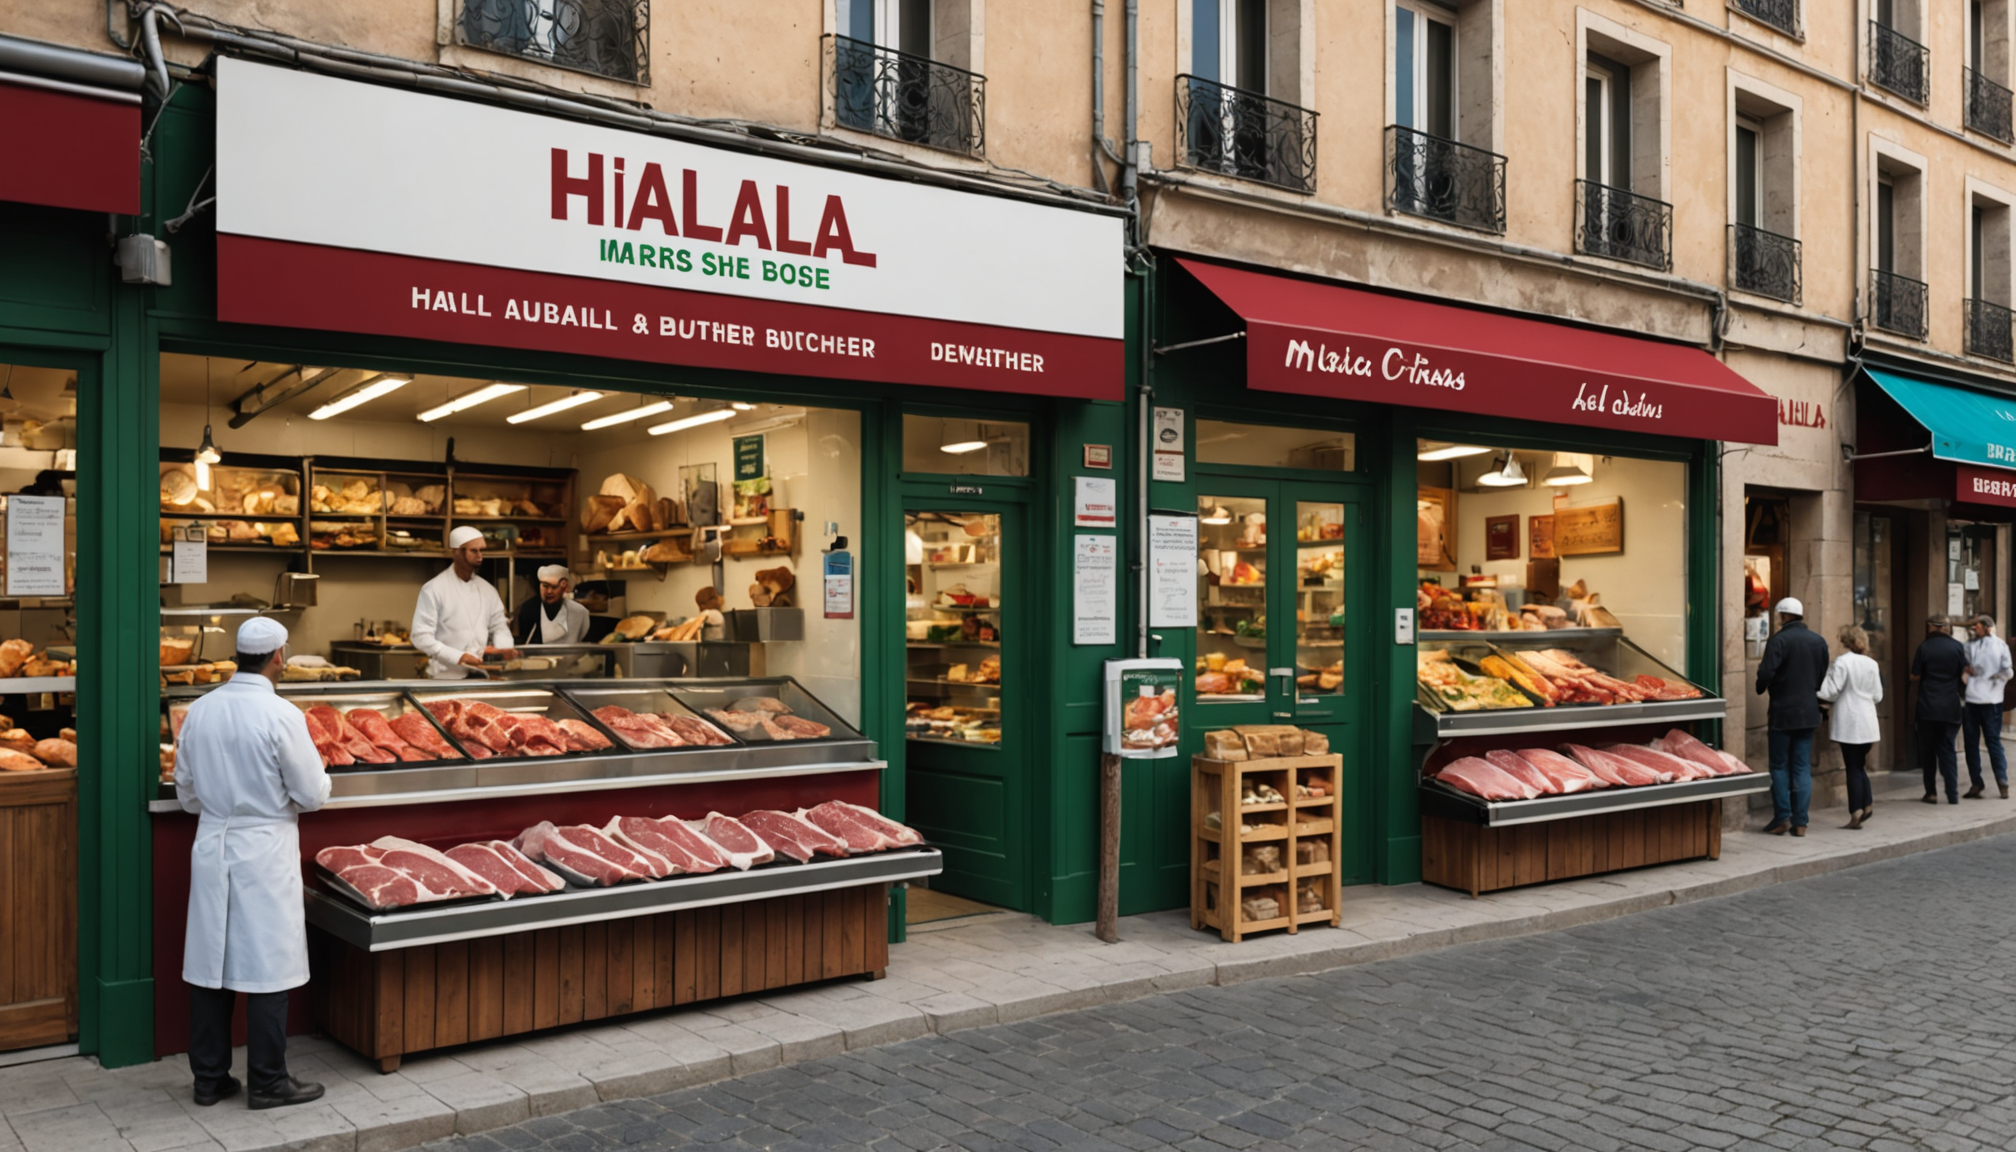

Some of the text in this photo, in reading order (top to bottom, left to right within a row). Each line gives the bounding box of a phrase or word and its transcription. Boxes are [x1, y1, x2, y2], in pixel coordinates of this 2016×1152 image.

[701, 251, 751, 280] SHE
[761, 259, 831, 290] BOSE
[504, 298, 619, 331] AUBAILL
[632, 313, 650, 335] &
